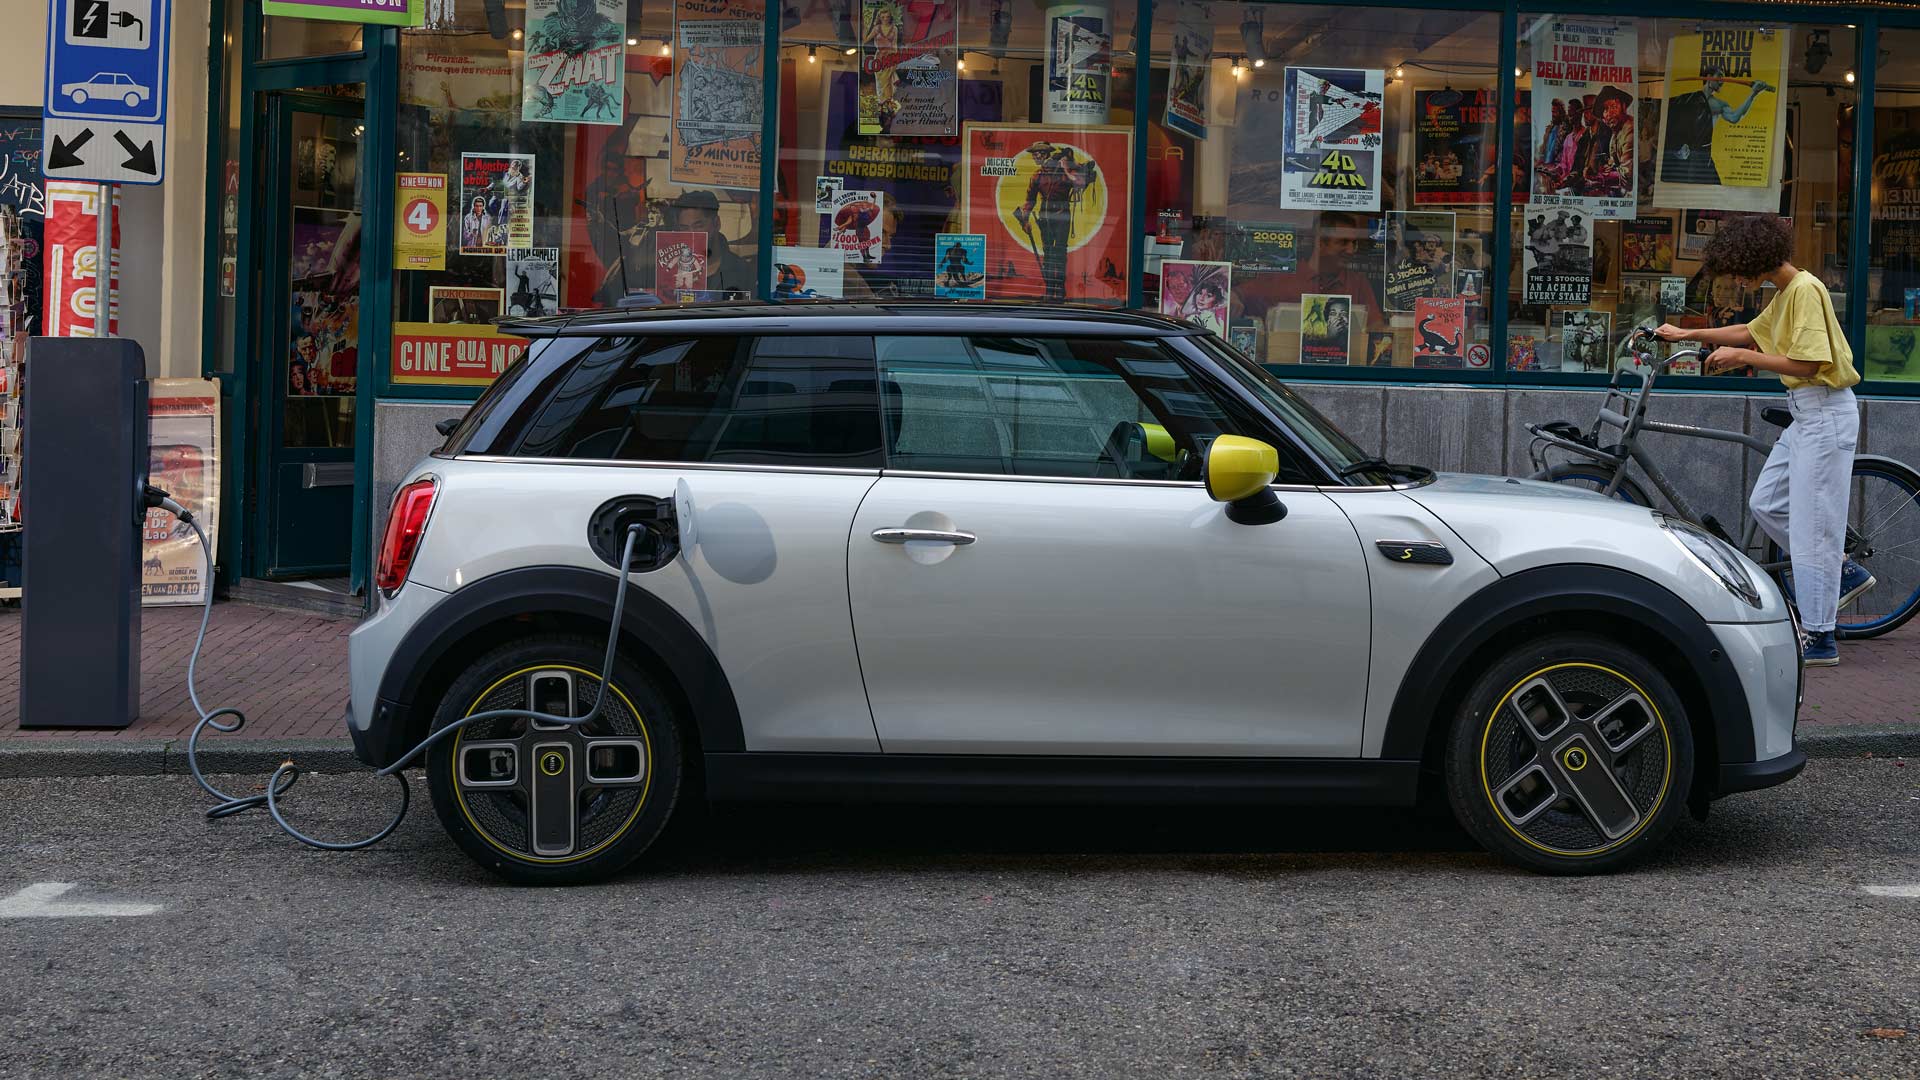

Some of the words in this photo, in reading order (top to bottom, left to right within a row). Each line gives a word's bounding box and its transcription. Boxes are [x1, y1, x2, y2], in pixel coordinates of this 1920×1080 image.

[685, 2, 727, 14] OUTLAW
[729, 8, 765, 21] NETWO
[1702, 31, 1754, 51] PARIU
[1562, 45, 1615, 65] QUATTRO
[444, 67, 459, 75] que
[528, 44, 622, 96] ZAAT
[1588, 65, 1633, 83] MARIA
[1066, 90, 1103, 101] MAN
[905, 103, 946, 112] startling
[704, 147, 761, 163] MINUTES
[848, 145, 925, 162] OPERAZIONE
[1321, 150, 1357, 171] 4D
[464, 158, 473, 170] Le
[475, 159, 510, 172] Monstre
[986, 158, 1016, 167] MICKEY
[828, 160, 949, 181] CONTROSPIONAGGIO
[982, 167, 1017, 176] HARGITAY
[401, 177, 417, 187] CINE
[428, 178, 443, 188] NON
[1312, 173, 1367, 187] MAN
[1543, 195, 1560, 205] SPENCER
[408, 202, 432, 231] 4
[842, 236, 882, 250] TOUCHDOWN
[1278, 241, 1293, 249] SEA
[508, 248, 516, 262] LE
[516, 248, 530, 262] FILM
[531, 248, 558, 262] COMPLET
[658, 243, 687, 258] BUSTER
[658, 249, 681, 268] KEATO
[1398, 258, 1412, 270] the
[1388, 272, 1396, 283] 3
[1396, 265, 1427, 280] STOOGES
[1554, 275, 1590, 283] STOOGES
[1546, 282, 1573, 292] ACHE
[1577, 283, 1589, 292] IN
[1529, 291, 1556, 300] EVERY
[400, 340, 452, 372] CINE
[457, 339, 487, 362] QUA
[491, 343, 530, 374] NO
[145, 529, 168, 541] Lao
[1401, 548, 1413, 560] S
[181, 583, 199, 595] LAO
